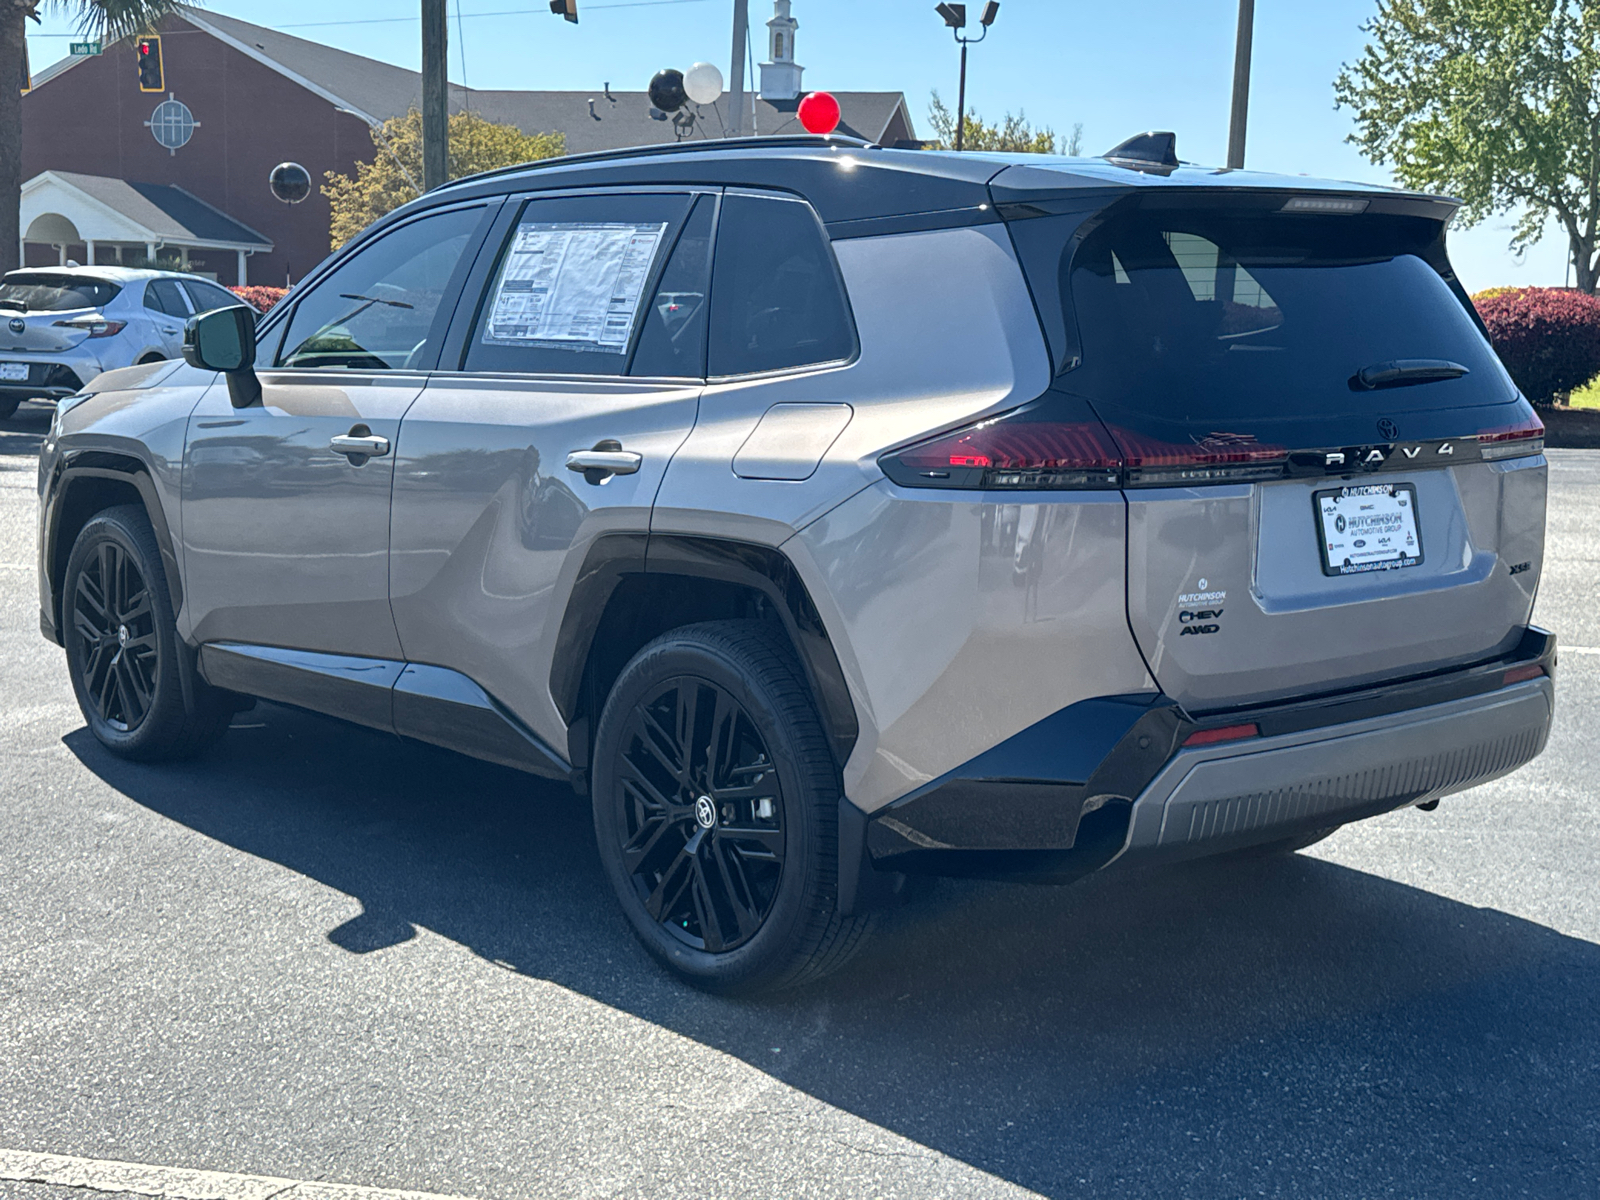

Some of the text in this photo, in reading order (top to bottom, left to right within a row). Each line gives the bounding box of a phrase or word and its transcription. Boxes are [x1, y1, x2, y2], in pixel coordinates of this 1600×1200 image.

[74, 43, 98, 54] Ledo Rd
[1350, 484, 1394, 497] HUTCHINSON
[1348, 514, 1403, 529] HUTCHINSON
[1350, 524, 1402, 537] AUTOMOTIVE GROUP
[1178, 591, 1226, 602] HUTCHINSON
[1180, 624, 1220, 636] AWD
